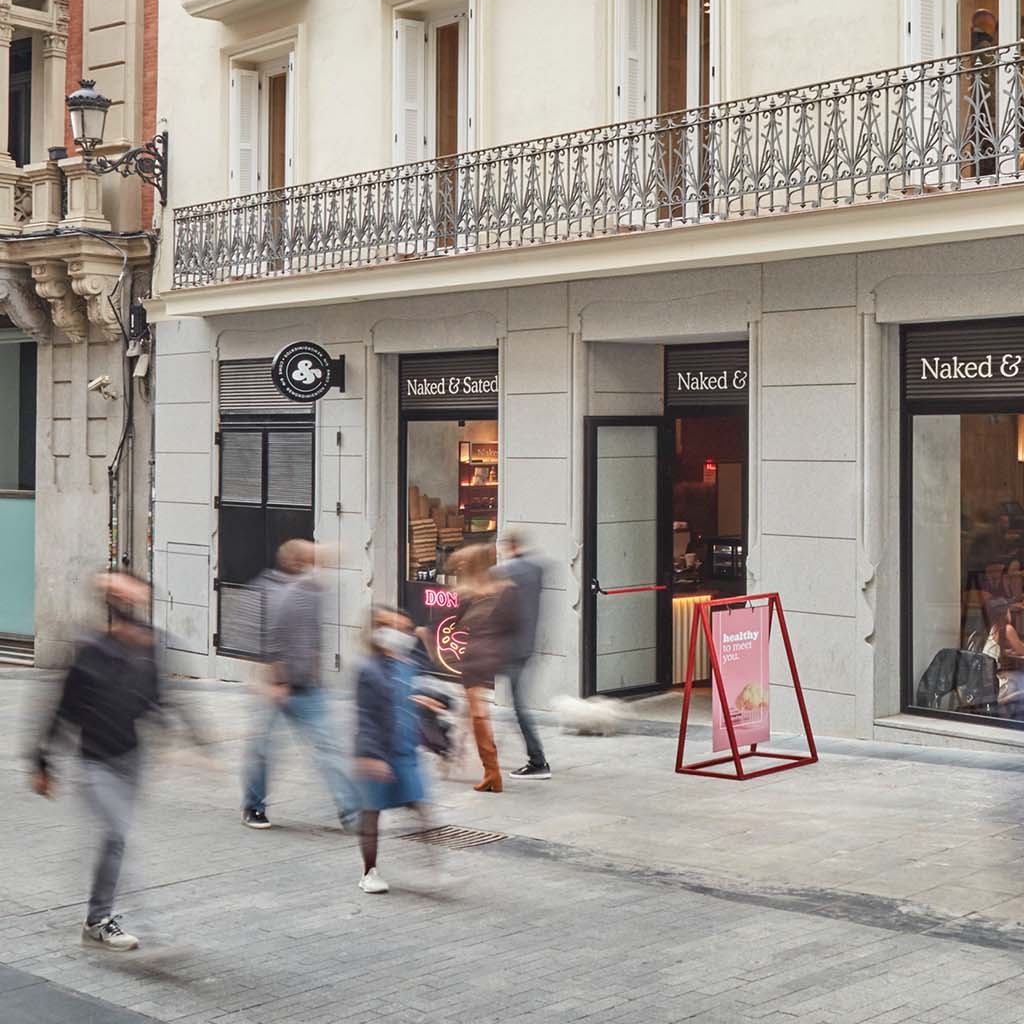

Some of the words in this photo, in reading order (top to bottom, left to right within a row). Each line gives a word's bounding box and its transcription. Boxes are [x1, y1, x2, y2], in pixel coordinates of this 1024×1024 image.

[920, 355, 993, 380] Naked
[1000, 354, 1022, 377] &
[407, 377, 446, 395] Naked
[448, 377, 460, 394] &
[462, 375, 498, 394] Sated
[677, 370, 728, 391] Naked
[732, 370, 748, 389] &
[425, 590, 458, 607] DON
[723, 630, 759, 643] healthy
[723, 644, 731, 653] to
[733, 642, 752, 651] meet
